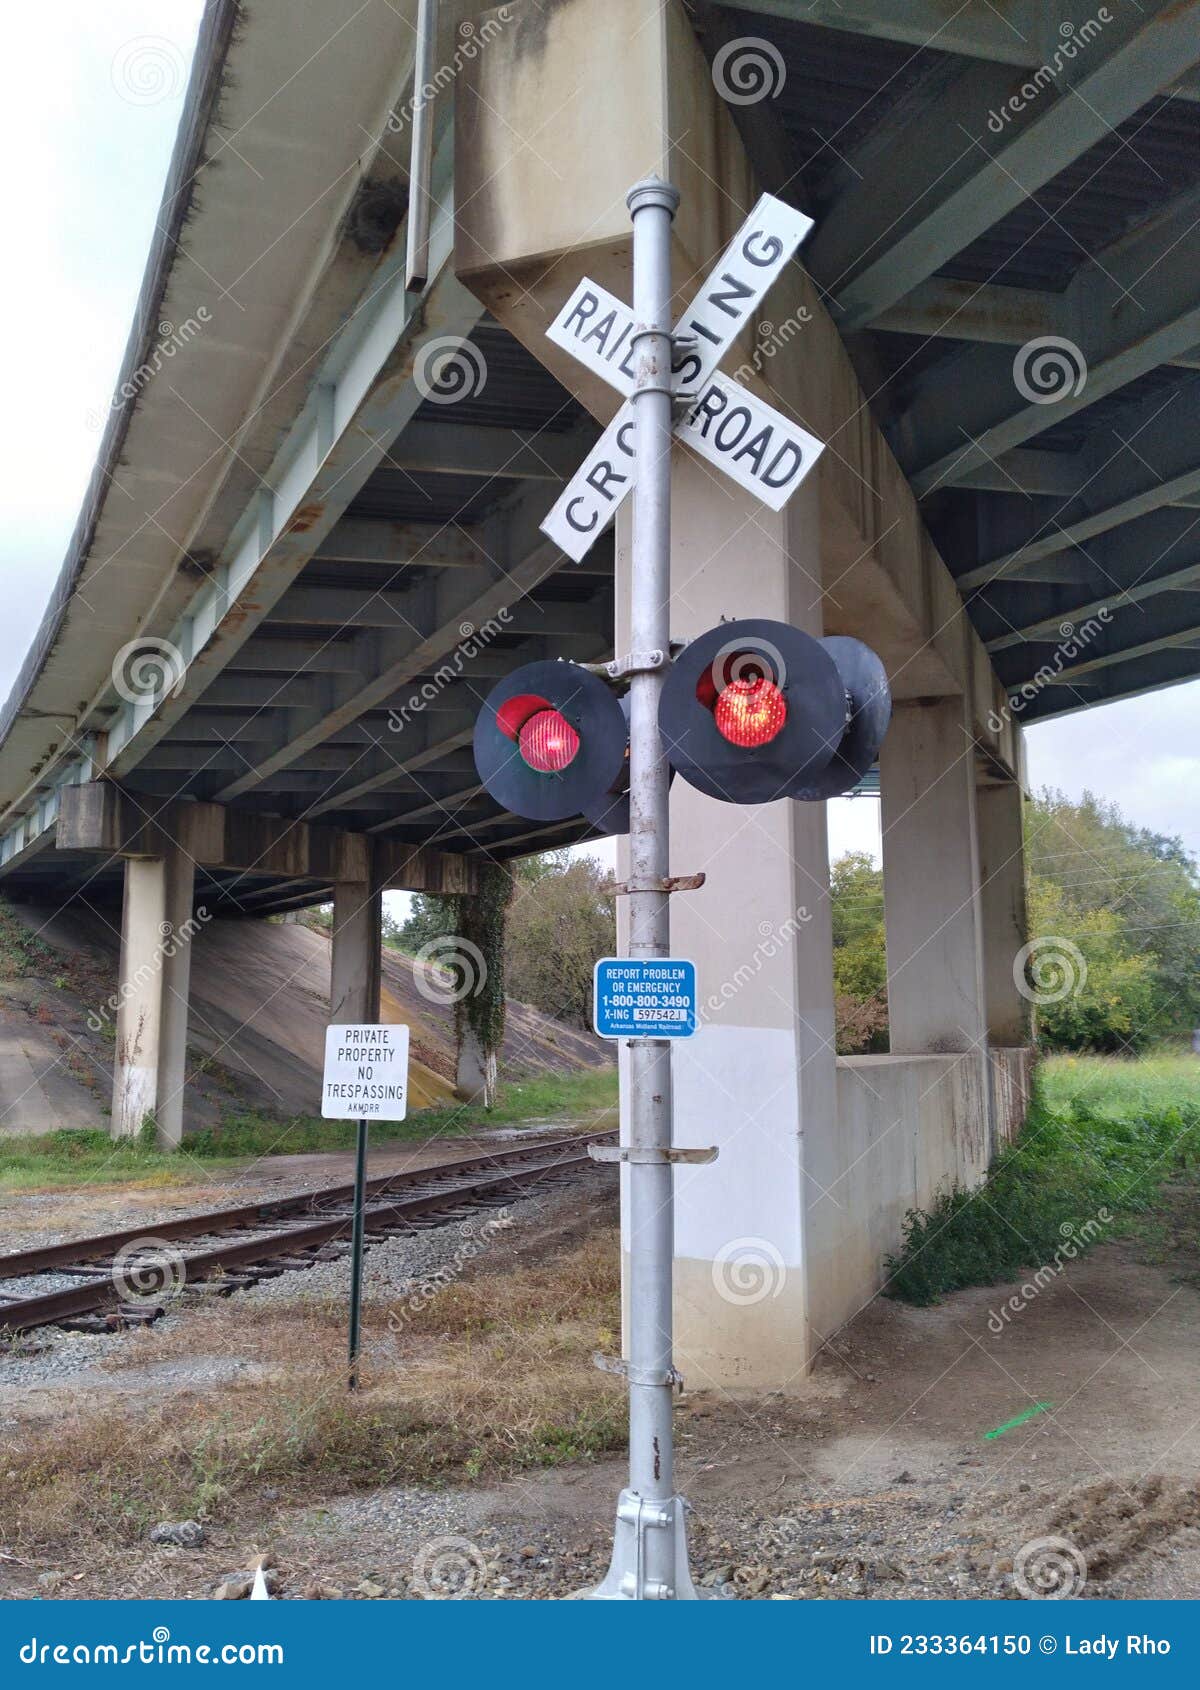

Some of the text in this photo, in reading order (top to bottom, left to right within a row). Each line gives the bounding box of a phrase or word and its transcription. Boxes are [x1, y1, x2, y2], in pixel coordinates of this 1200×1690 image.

[606, 968, 685, 979] REPORT PROBLEM
[612, 982, 681, 993] OR EMERGENCY
[602, 995, 690, 1008] 1-800-800-3490
[604, 1009, 630, 1020] X-ING
[345, 1030, 390, 1044] PRIVATE
[337, 1048, 395, 1062] PROPERTY
[357, 1066, 373, 1080] NO
[327, 1083, 404, 1100] TRESPASSING
